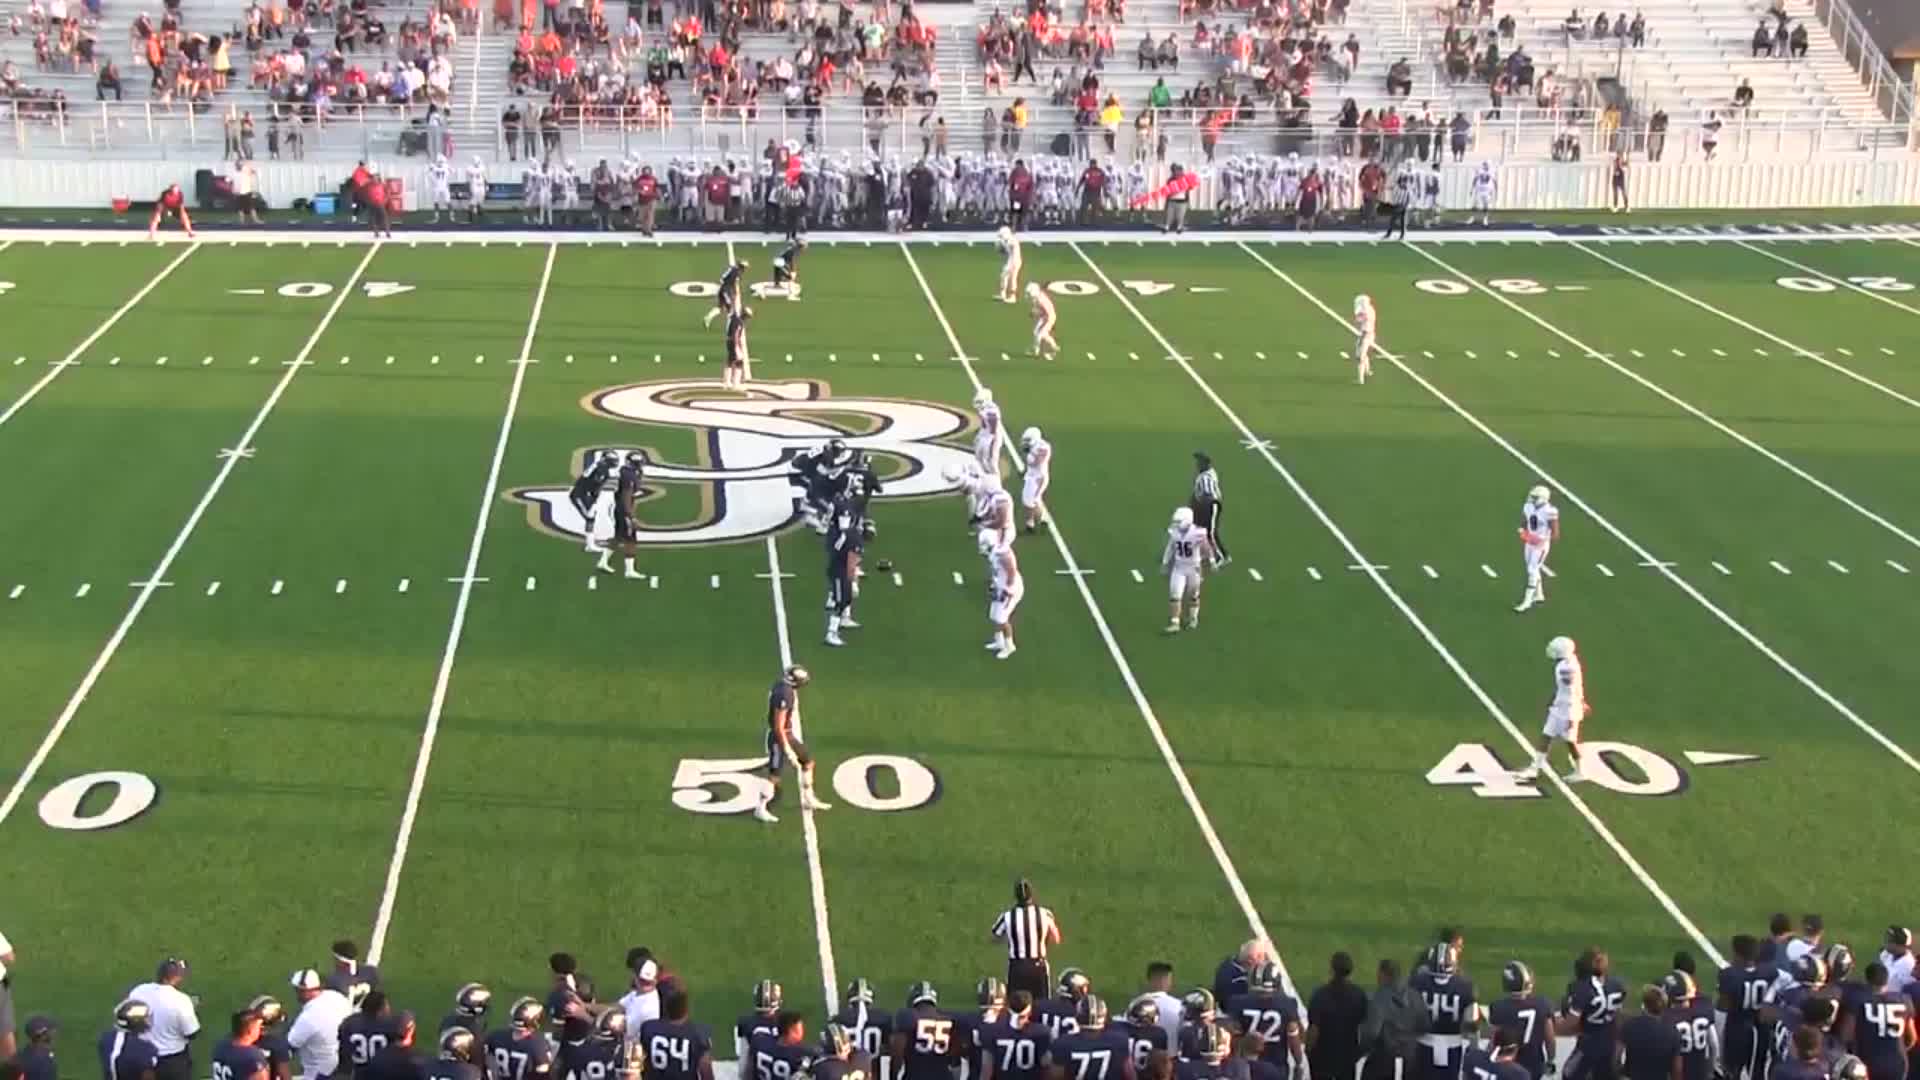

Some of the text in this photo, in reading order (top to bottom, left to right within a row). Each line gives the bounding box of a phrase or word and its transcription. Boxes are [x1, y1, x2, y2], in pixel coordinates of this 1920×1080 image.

[672, 754, 938, 813] 50
[1425, 740, 1684, 798] 40
[38, 771, 157, 831] 0
[1422, 991, 1460, 1022] 44
[1864, 1002, 1907, 1038] 45
[915, 1018, 953, 1054] 55
[1242, 1009, 1282, 1043] 72
[1517, 1009, 1537, 1044] 7
[494, 1047, 528, 1079] 87
[650, 1035, 690, 1071] 64
[756, 1051, 791, 1080] 59
[996, 1038, 1036, 1071] 70
[1071, 1049, 1112, 1080] 77
